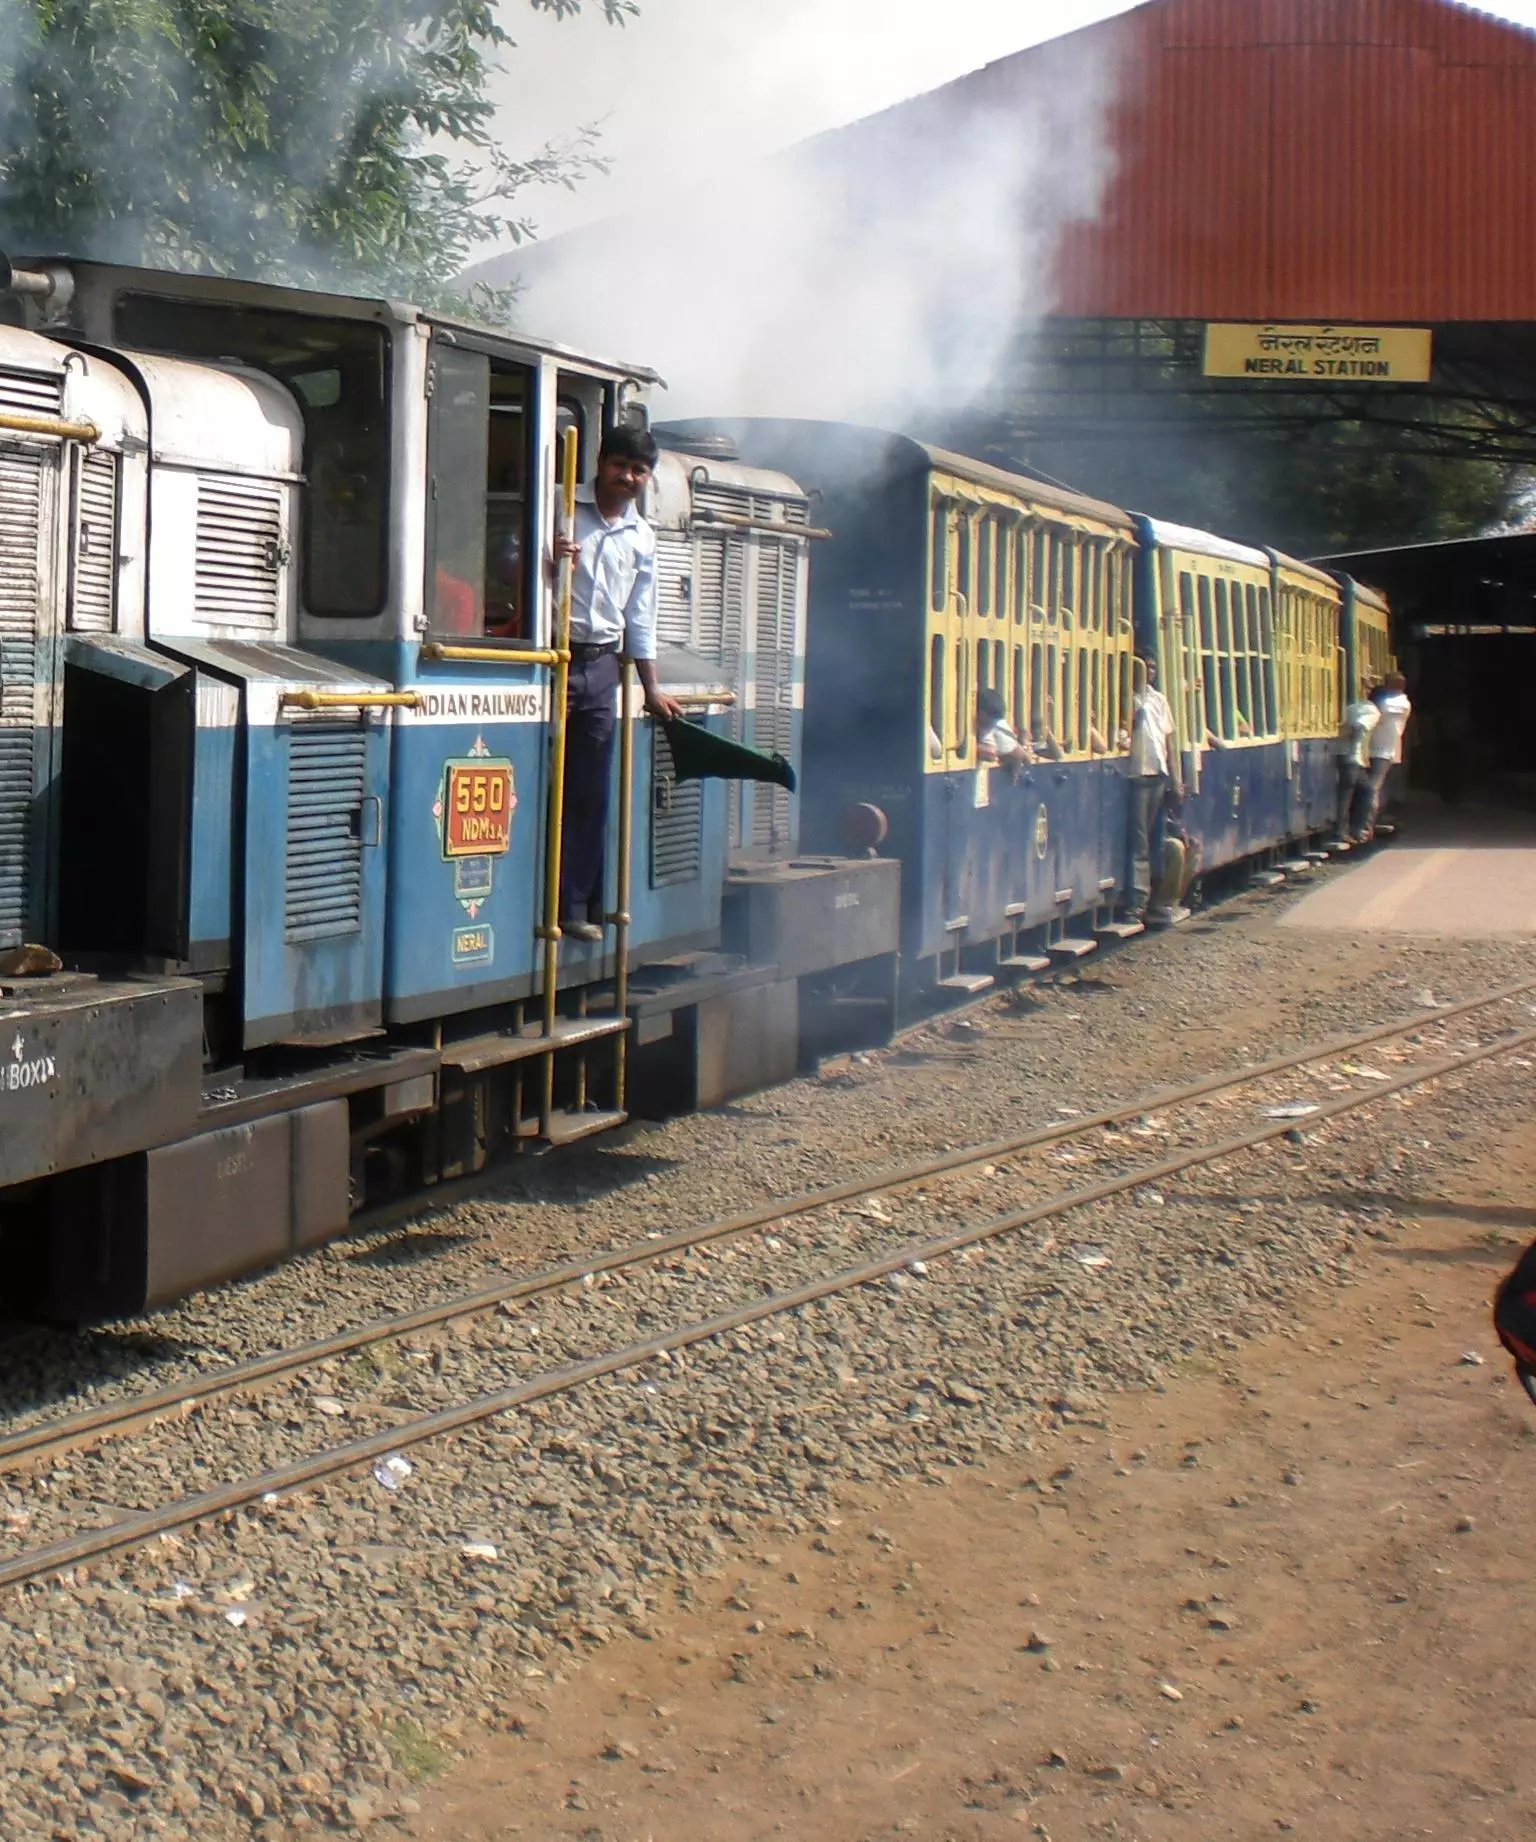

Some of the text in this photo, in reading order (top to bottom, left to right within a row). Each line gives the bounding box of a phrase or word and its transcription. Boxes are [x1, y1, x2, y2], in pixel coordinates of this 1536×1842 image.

[1244, 358, 1389, 375] NERAL STATION
[471, 693, 537, 716] RAILWAYS
[456, 776, 503, 812] 550
[456, 932, 488, 952] NERAL
